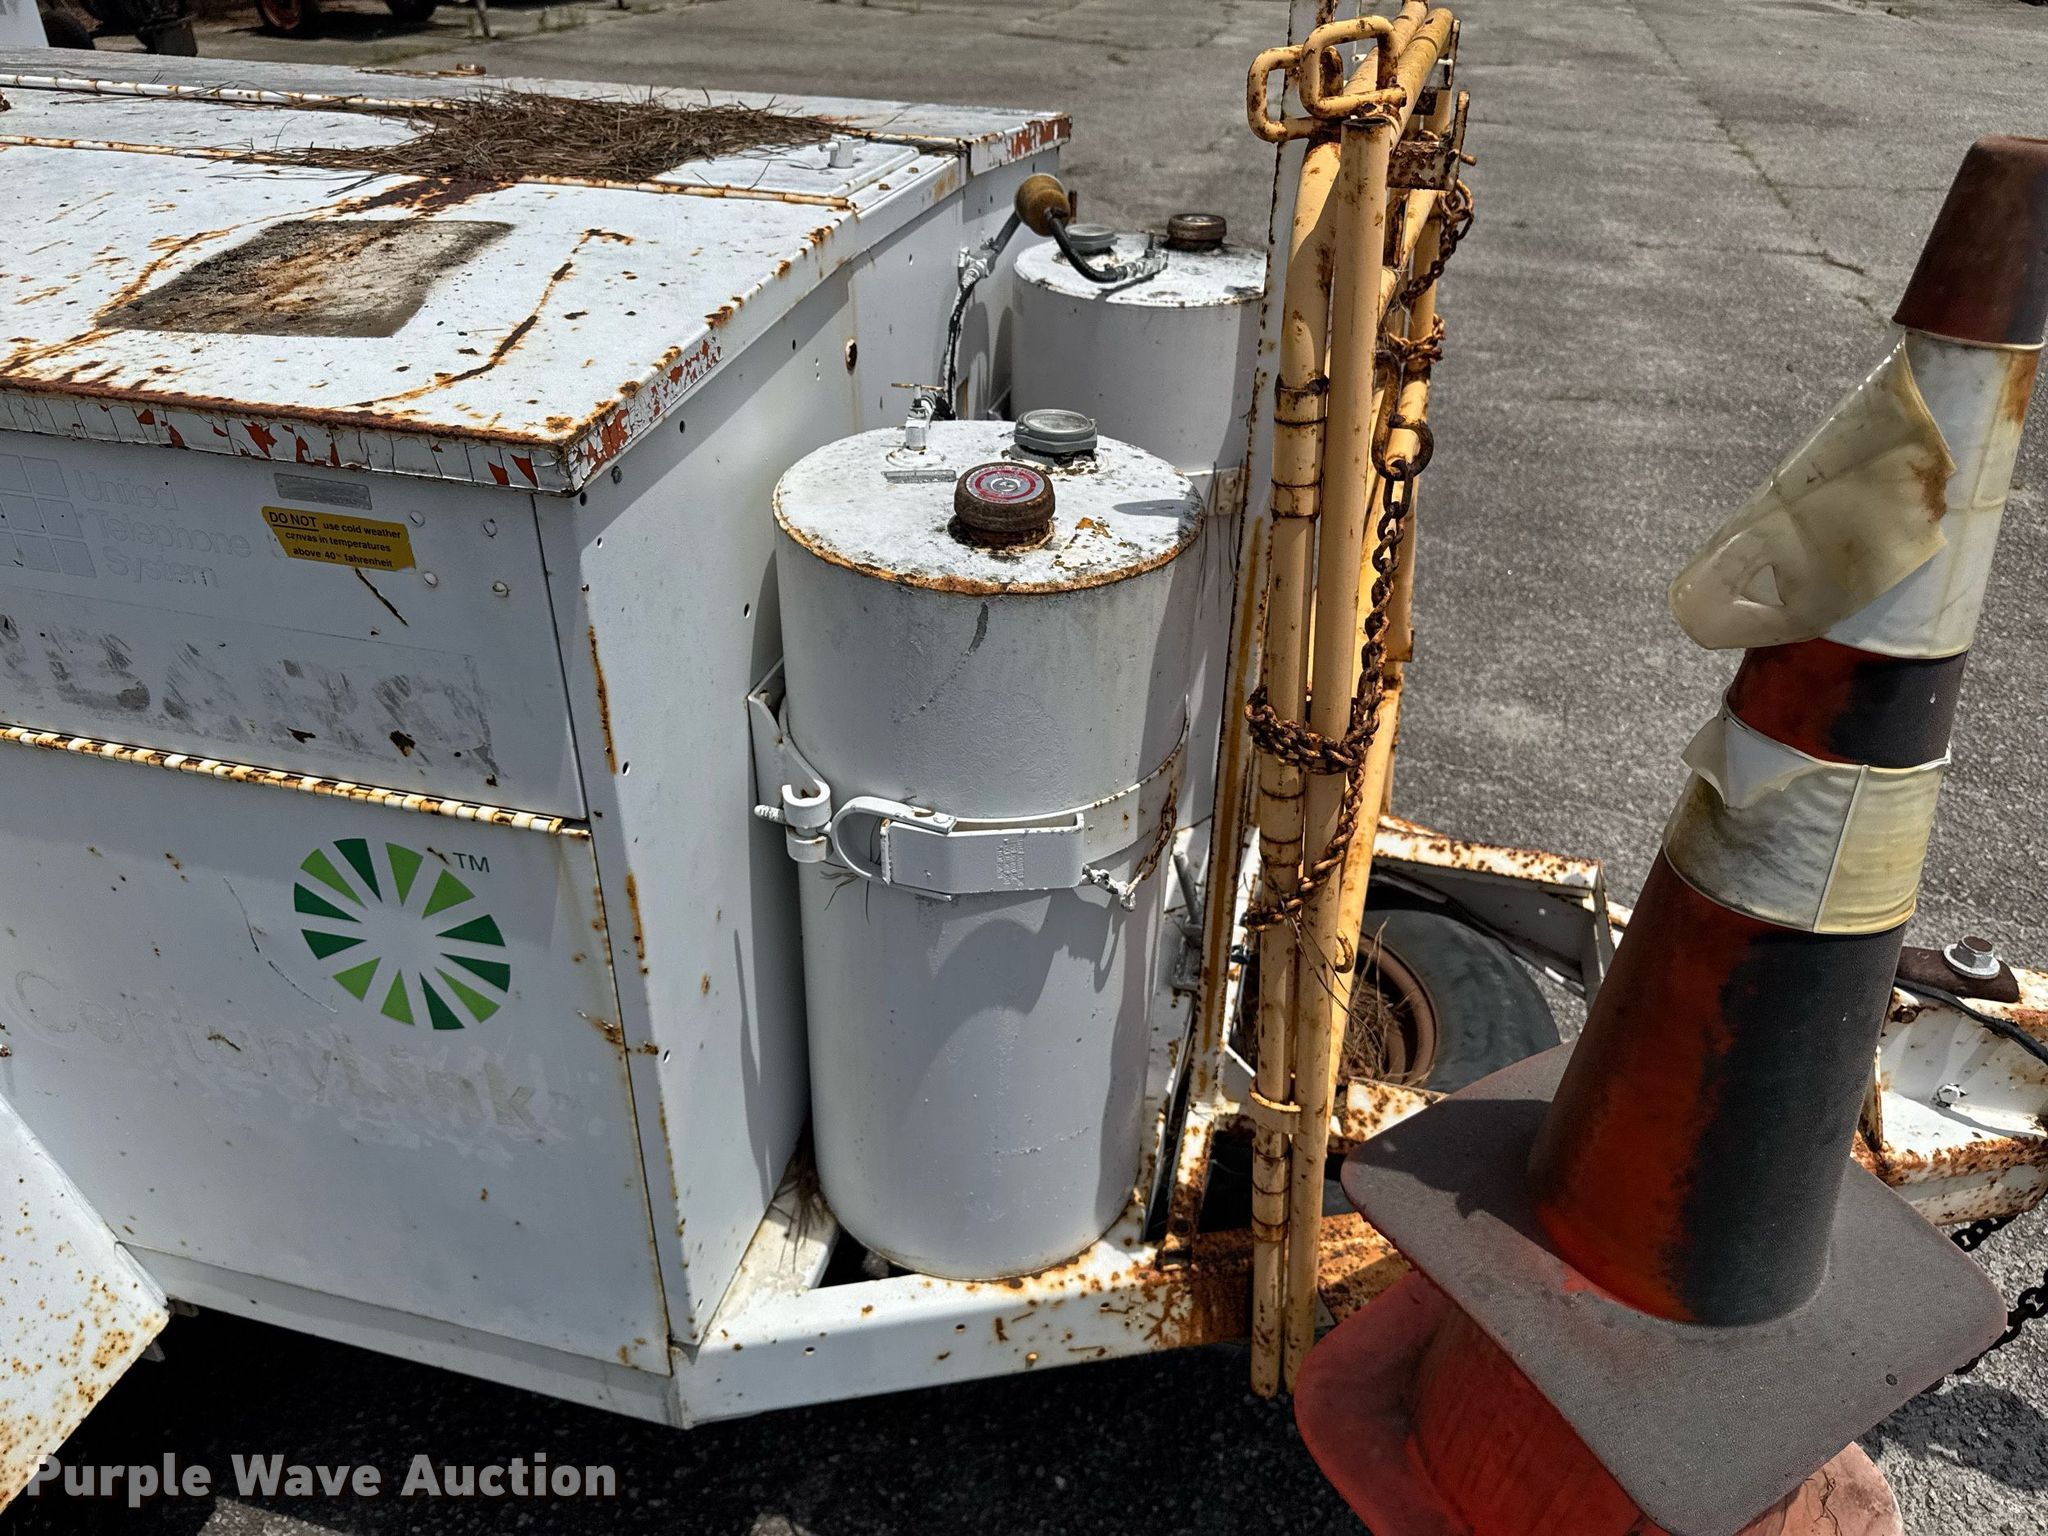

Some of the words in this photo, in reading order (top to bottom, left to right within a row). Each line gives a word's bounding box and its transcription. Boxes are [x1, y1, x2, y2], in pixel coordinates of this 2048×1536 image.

[269, 511, 289, 524] DO
[291, 512, 318, 529] NOT
[323, 522, 340, 531] use
[342, 524, 362, 533] cold
[364, 528, 401, 539] weather
[285, 532, 318, 543] canvas
[330, 537, 391, 552] temperatures
[293, 547, 321, 558] above
[344, 554, 392, 568] fahrenheit
[452, 852, 490, 873] TM
